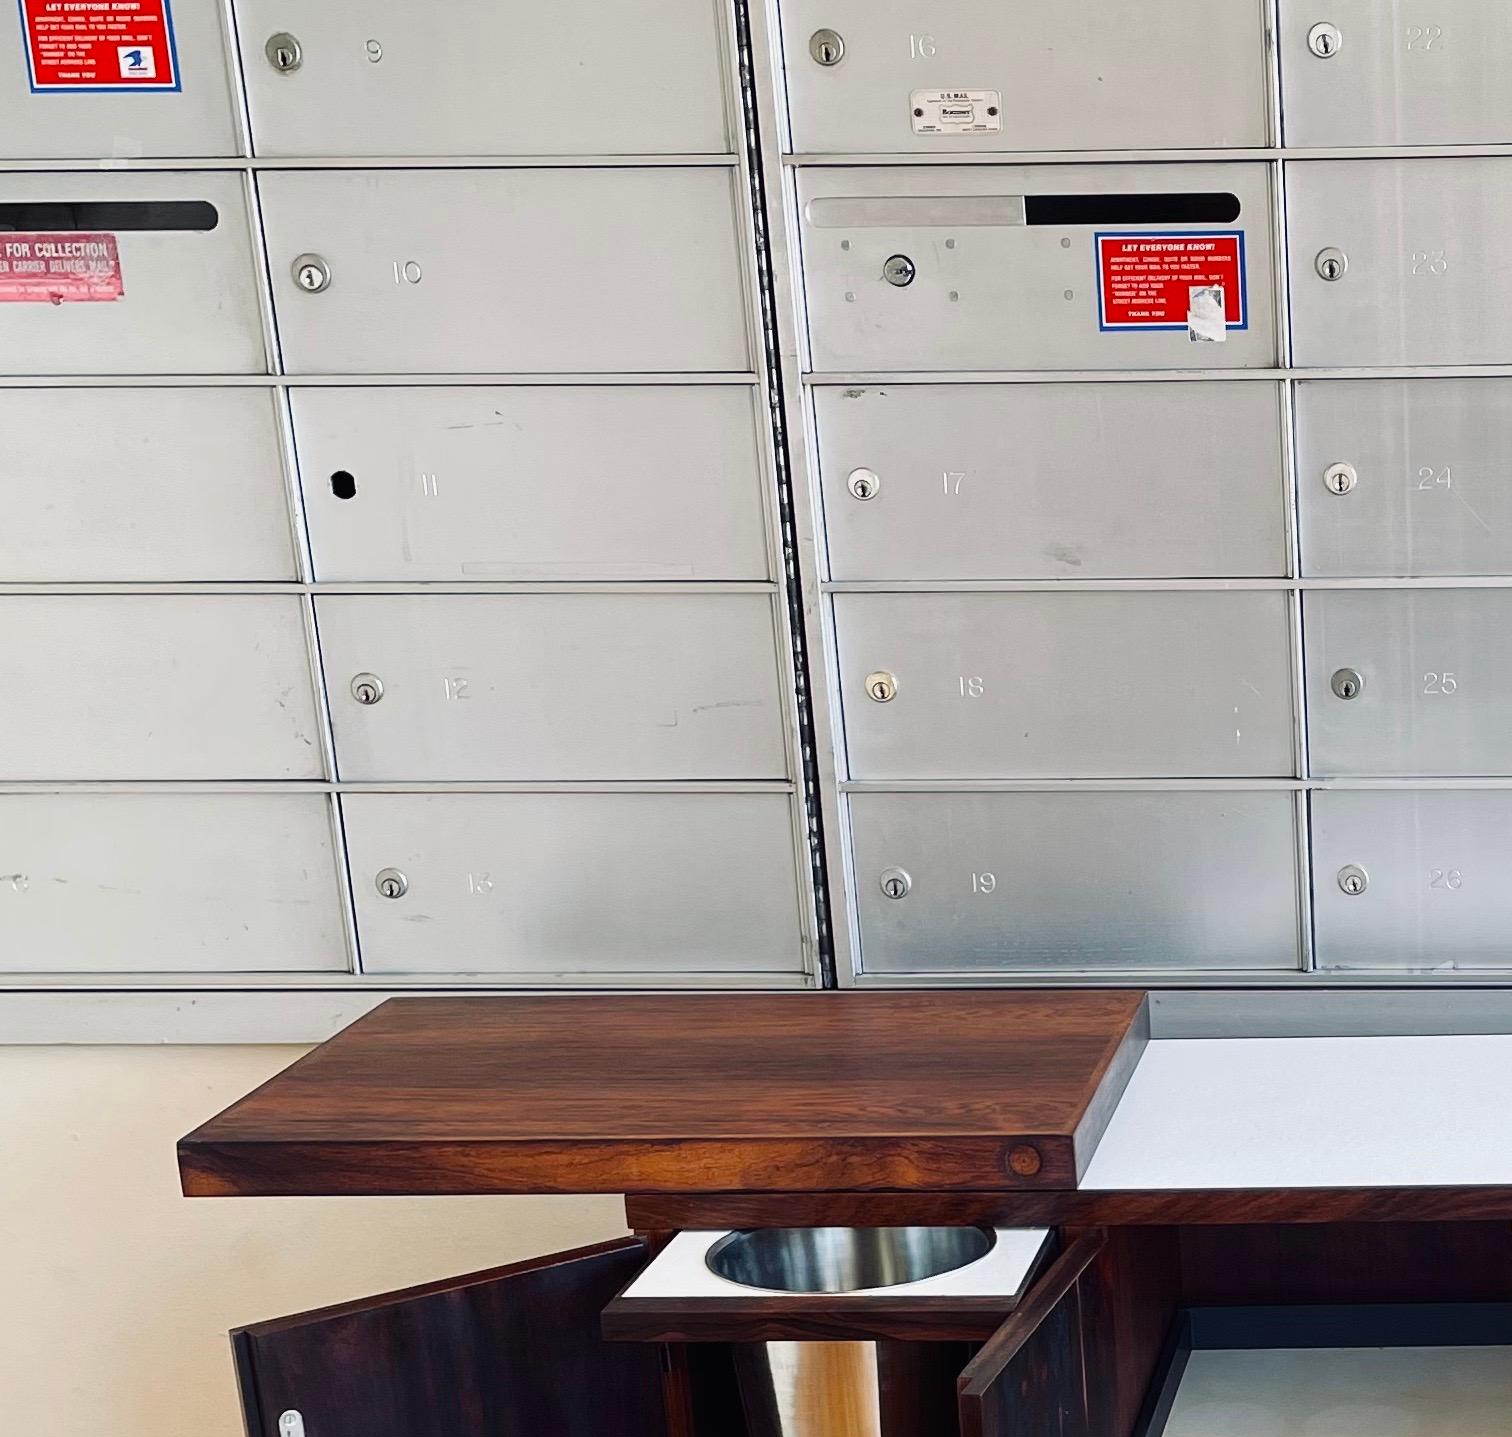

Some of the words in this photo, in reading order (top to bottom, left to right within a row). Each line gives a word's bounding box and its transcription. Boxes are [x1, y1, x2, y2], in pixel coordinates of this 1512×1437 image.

[908, 33, 936, 58] 16
[1407, 26, 1442, 50] 22
[366, 39, 383, 63] 9
[5, 242, 30, 258] FOR
[34, 242, 108, 258] COLLECTION
[394, 261, 422, 285] 10
[421, 474, 440, 496] 11
[942, 472, 965, 495] 17
[1418, 466, 1453, 490] 24
[443, 676, 470, 700] 12
[959, 675, 984, 698] 18
[1423, 672, 1458, 695] 25
[972, 872, 996, 894] 19
[1429, 868, 1463, 891] 26
